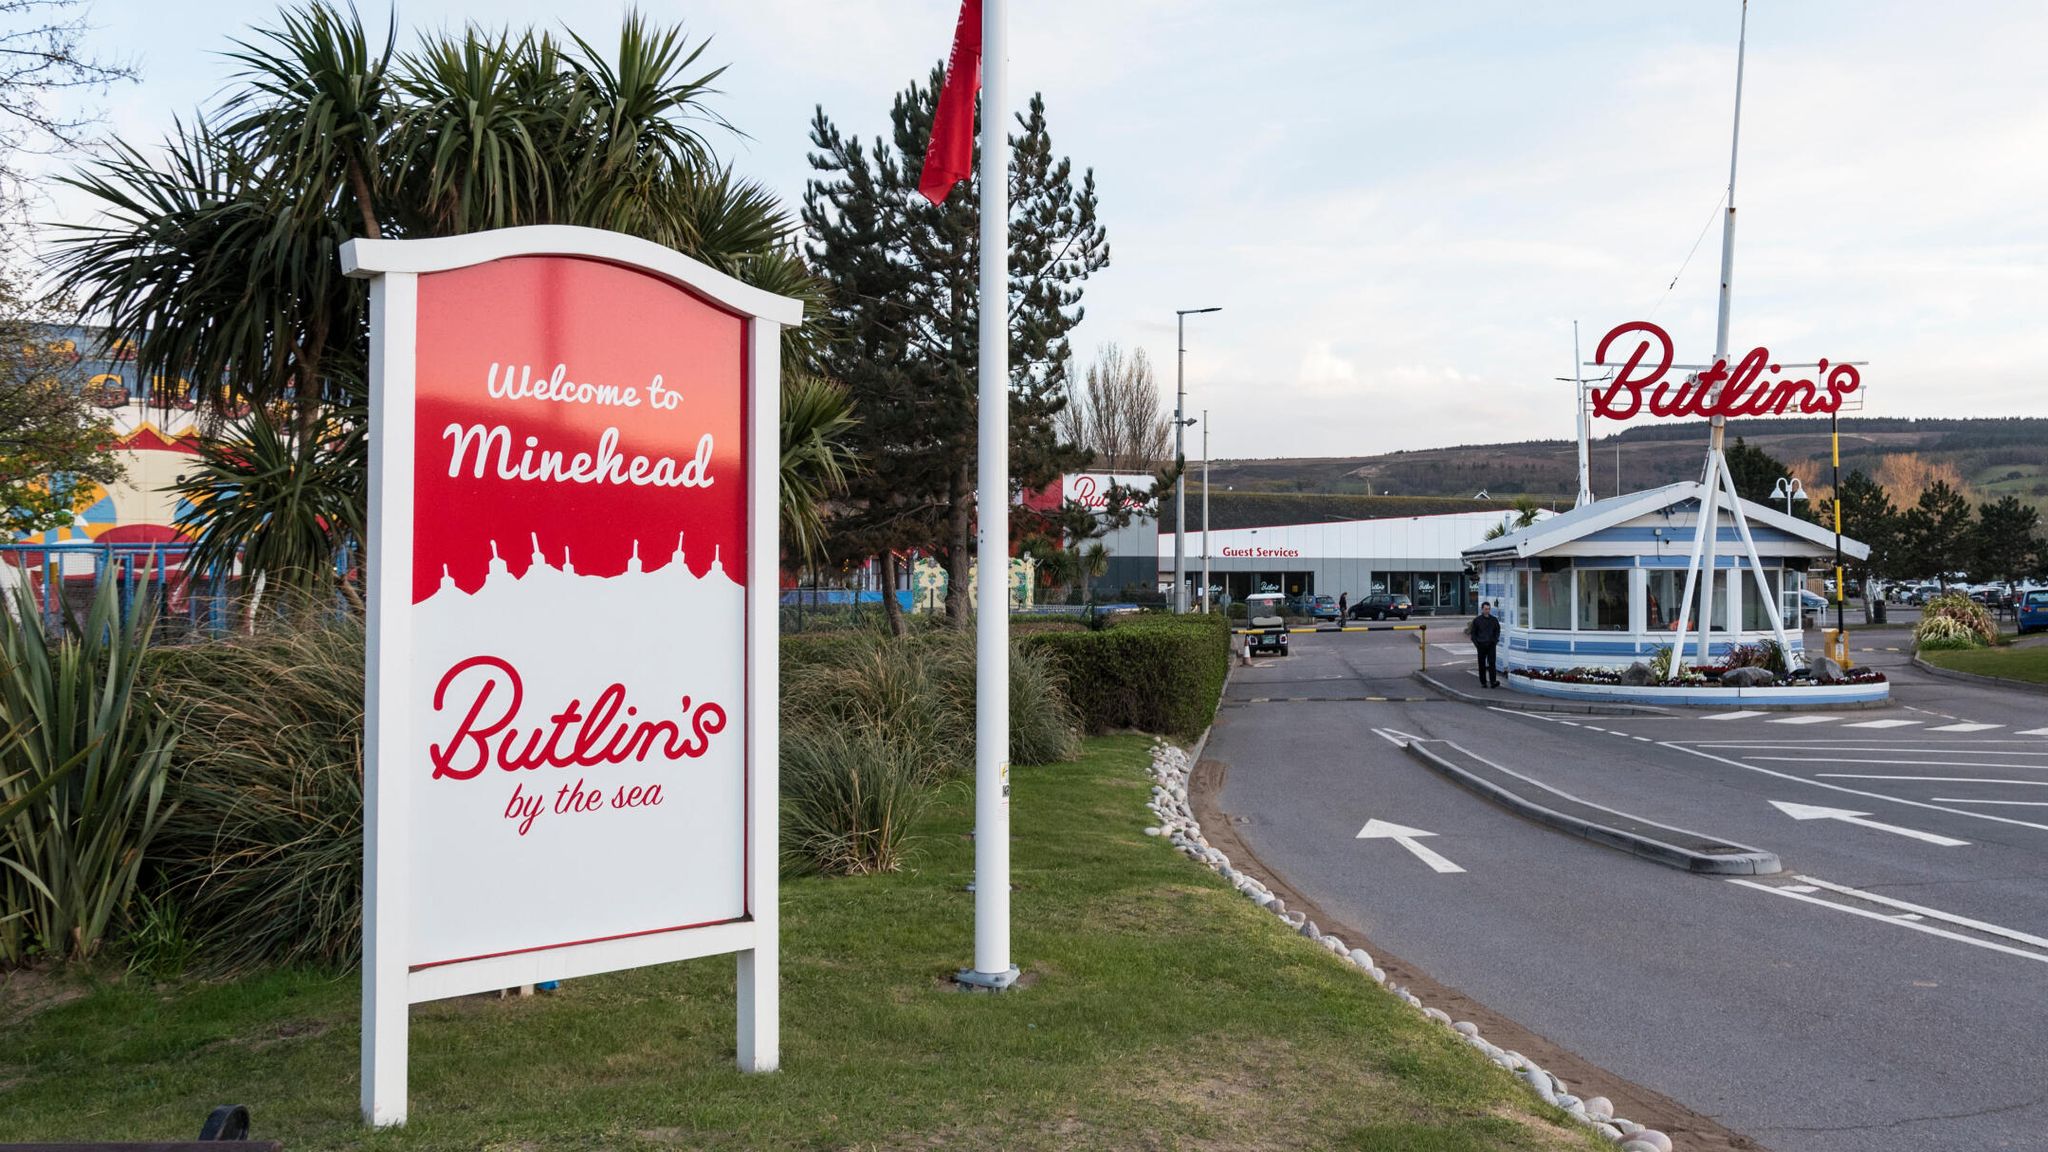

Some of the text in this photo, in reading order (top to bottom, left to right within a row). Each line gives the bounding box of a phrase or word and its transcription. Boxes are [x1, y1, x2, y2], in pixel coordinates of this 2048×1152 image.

[487, 362, 685, 411] Welcome to
[1591, 321, 1860, 421] Butlin's
[443, 423, 715, 488] Minehead
[1222, 546, 1299, 557] Guest Services
[429, 655, 727, 781] Butlin's
[504, 777, 664, 836] by the sea
